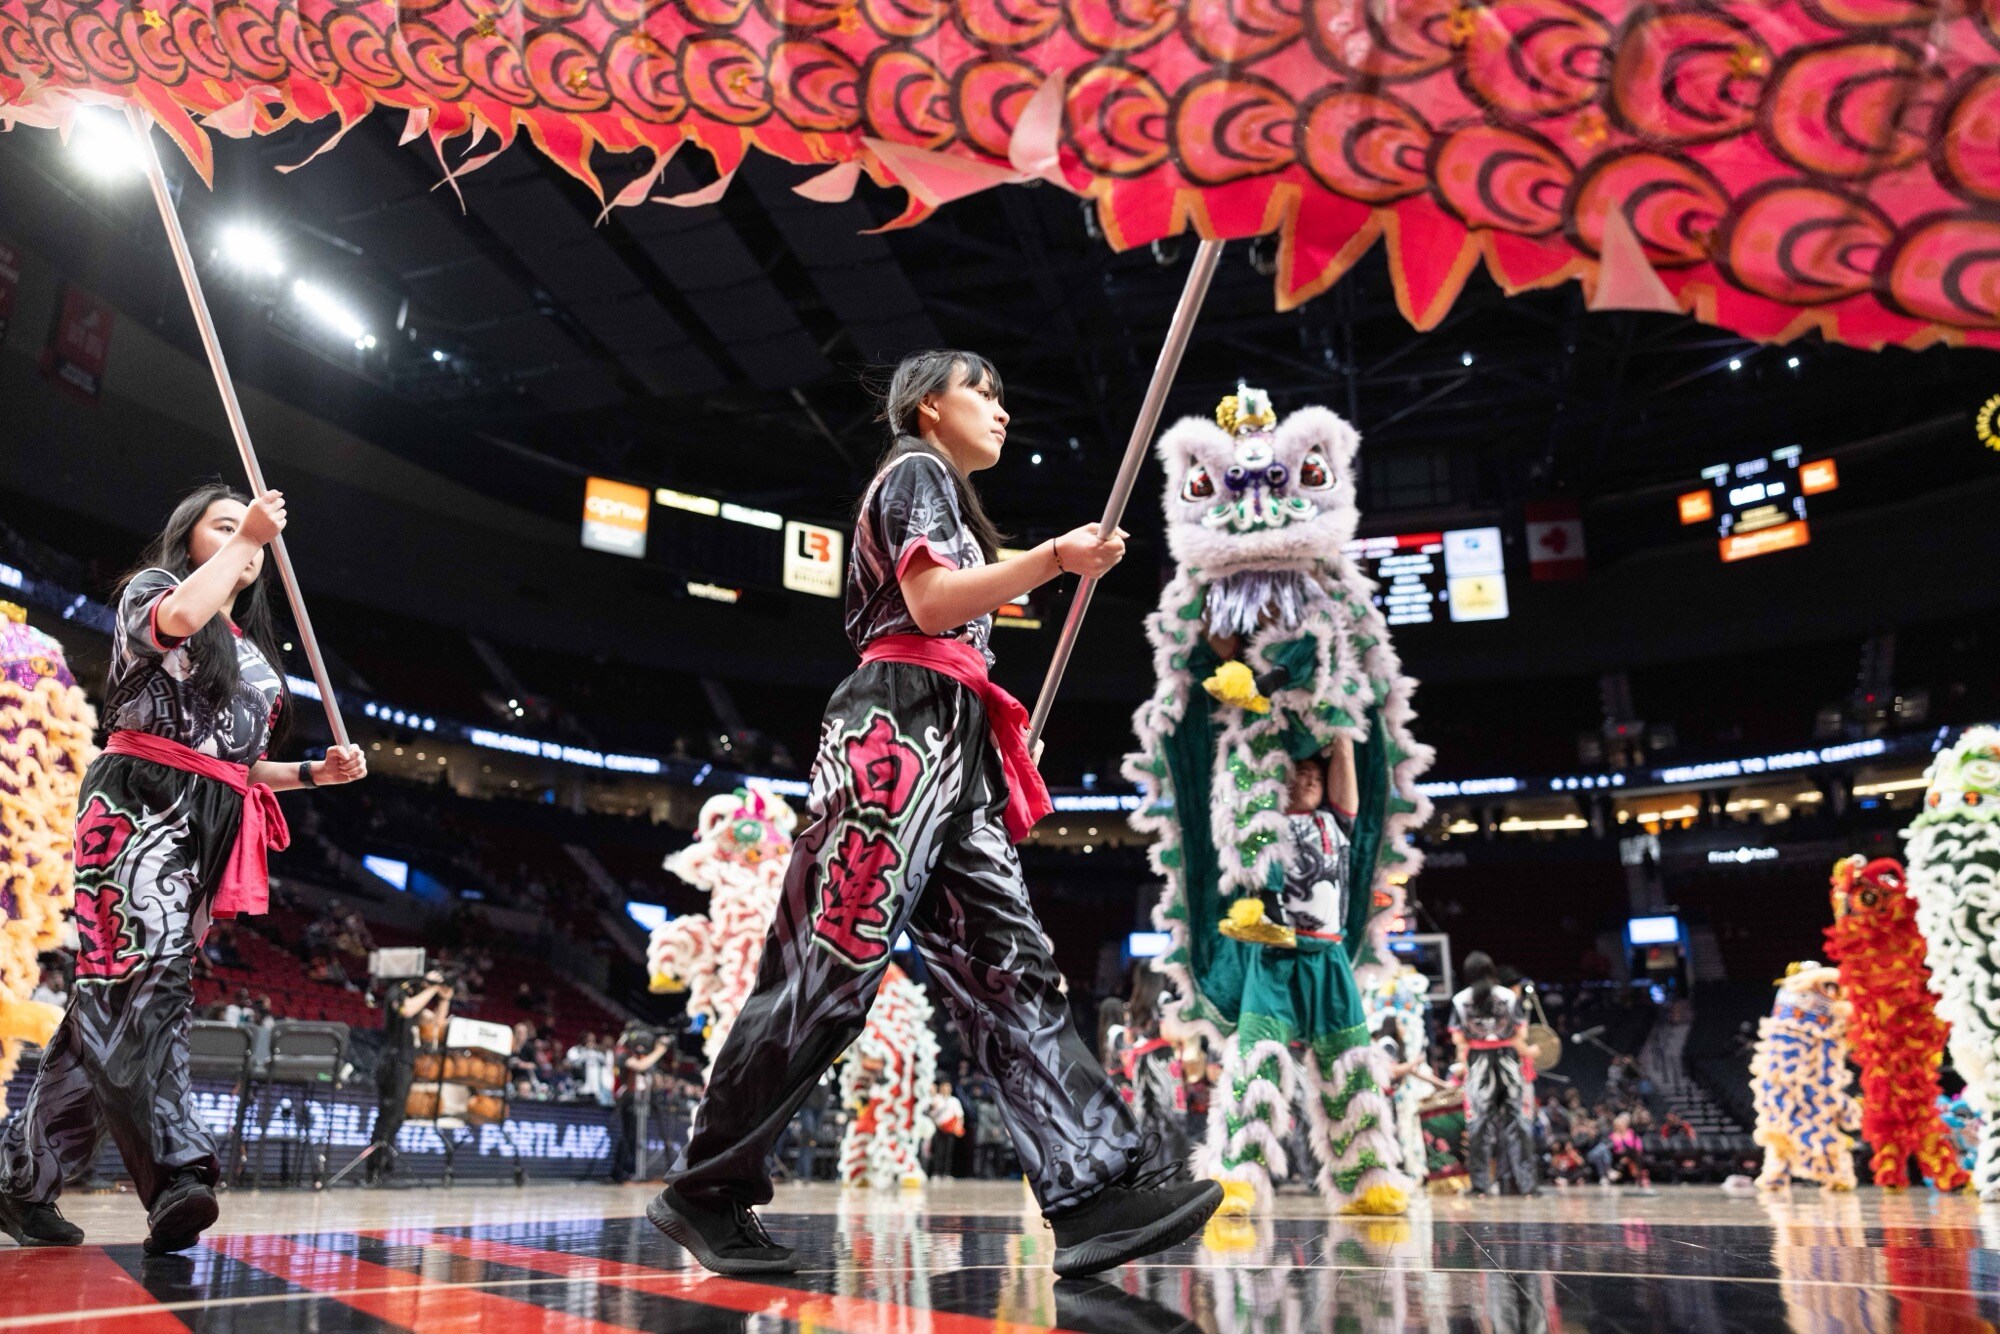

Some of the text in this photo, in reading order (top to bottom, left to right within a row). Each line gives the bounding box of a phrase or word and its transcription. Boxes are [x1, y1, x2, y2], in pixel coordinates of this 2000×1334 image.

[1662, 760, 1740, 784] WELCOME
[1740, 757, 1767, 774] TO
[1820, 740, 1885, 763] CENTER
